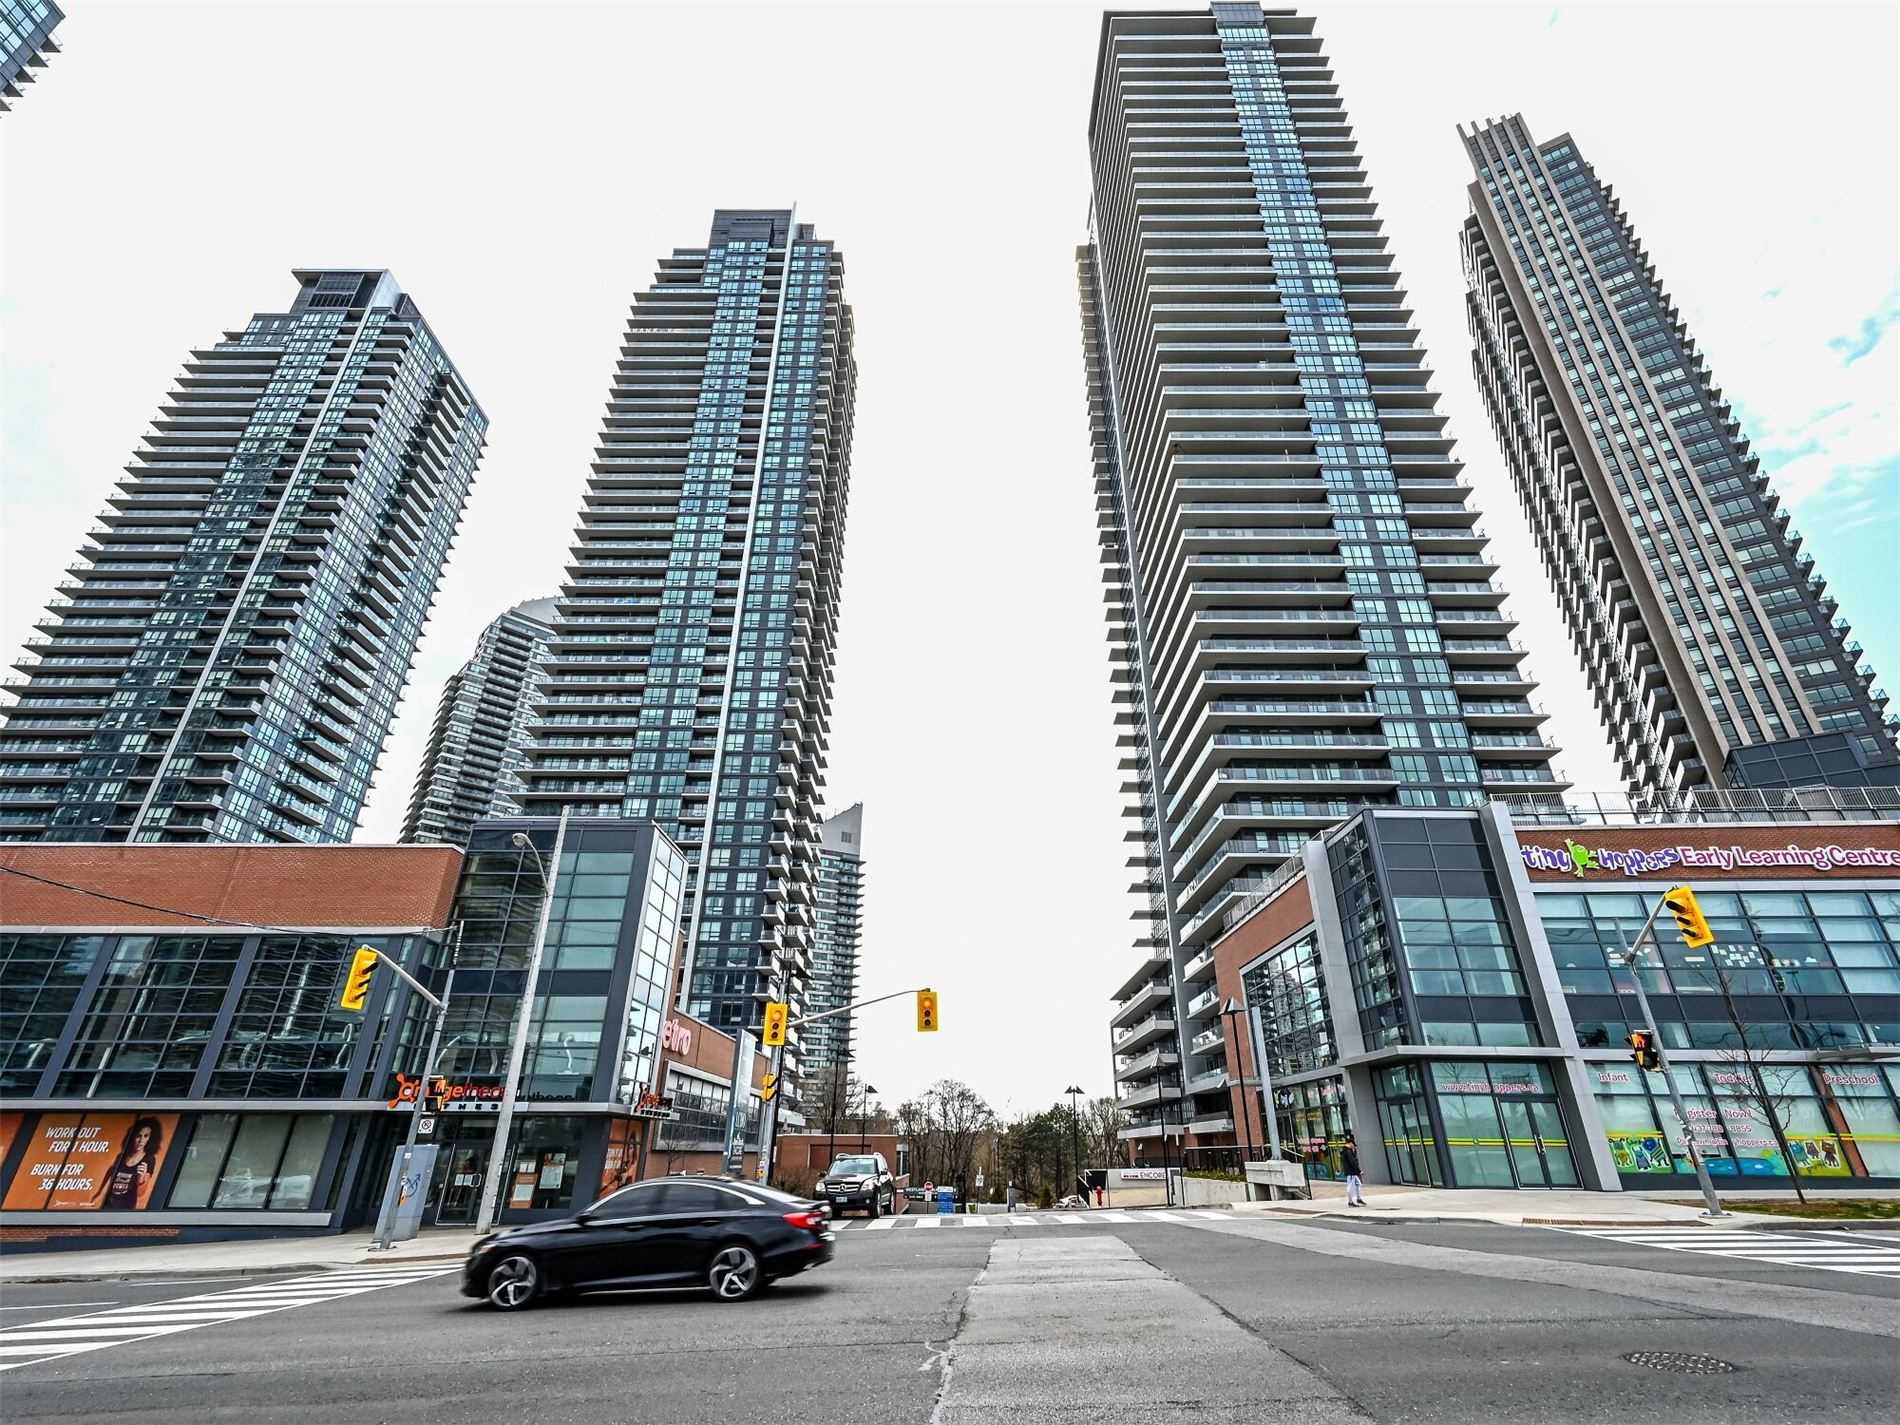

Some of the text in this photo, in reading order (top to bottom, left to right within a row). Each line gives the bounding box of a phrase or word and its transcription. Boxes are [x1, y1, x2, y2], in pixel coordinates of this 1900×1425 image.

[1521, 846, 1571, 873] tiny
[1681, 846, 1732, 870] Early
[1735, 845, 1827, 872] Learning
[1829, 846, 1900, 868] Centre
[1823, 1073, 1879, 1084] Preschool
[45, 1127, 101, 1138] WORK OUT
[48, 1141, 70, 1152] FOR
[80, 1141, 109, 1152] HOUR.
[30, 1163, 85, 1175] BURN FOR
[38, 1178, 94, 1190] 36 HOURS.
